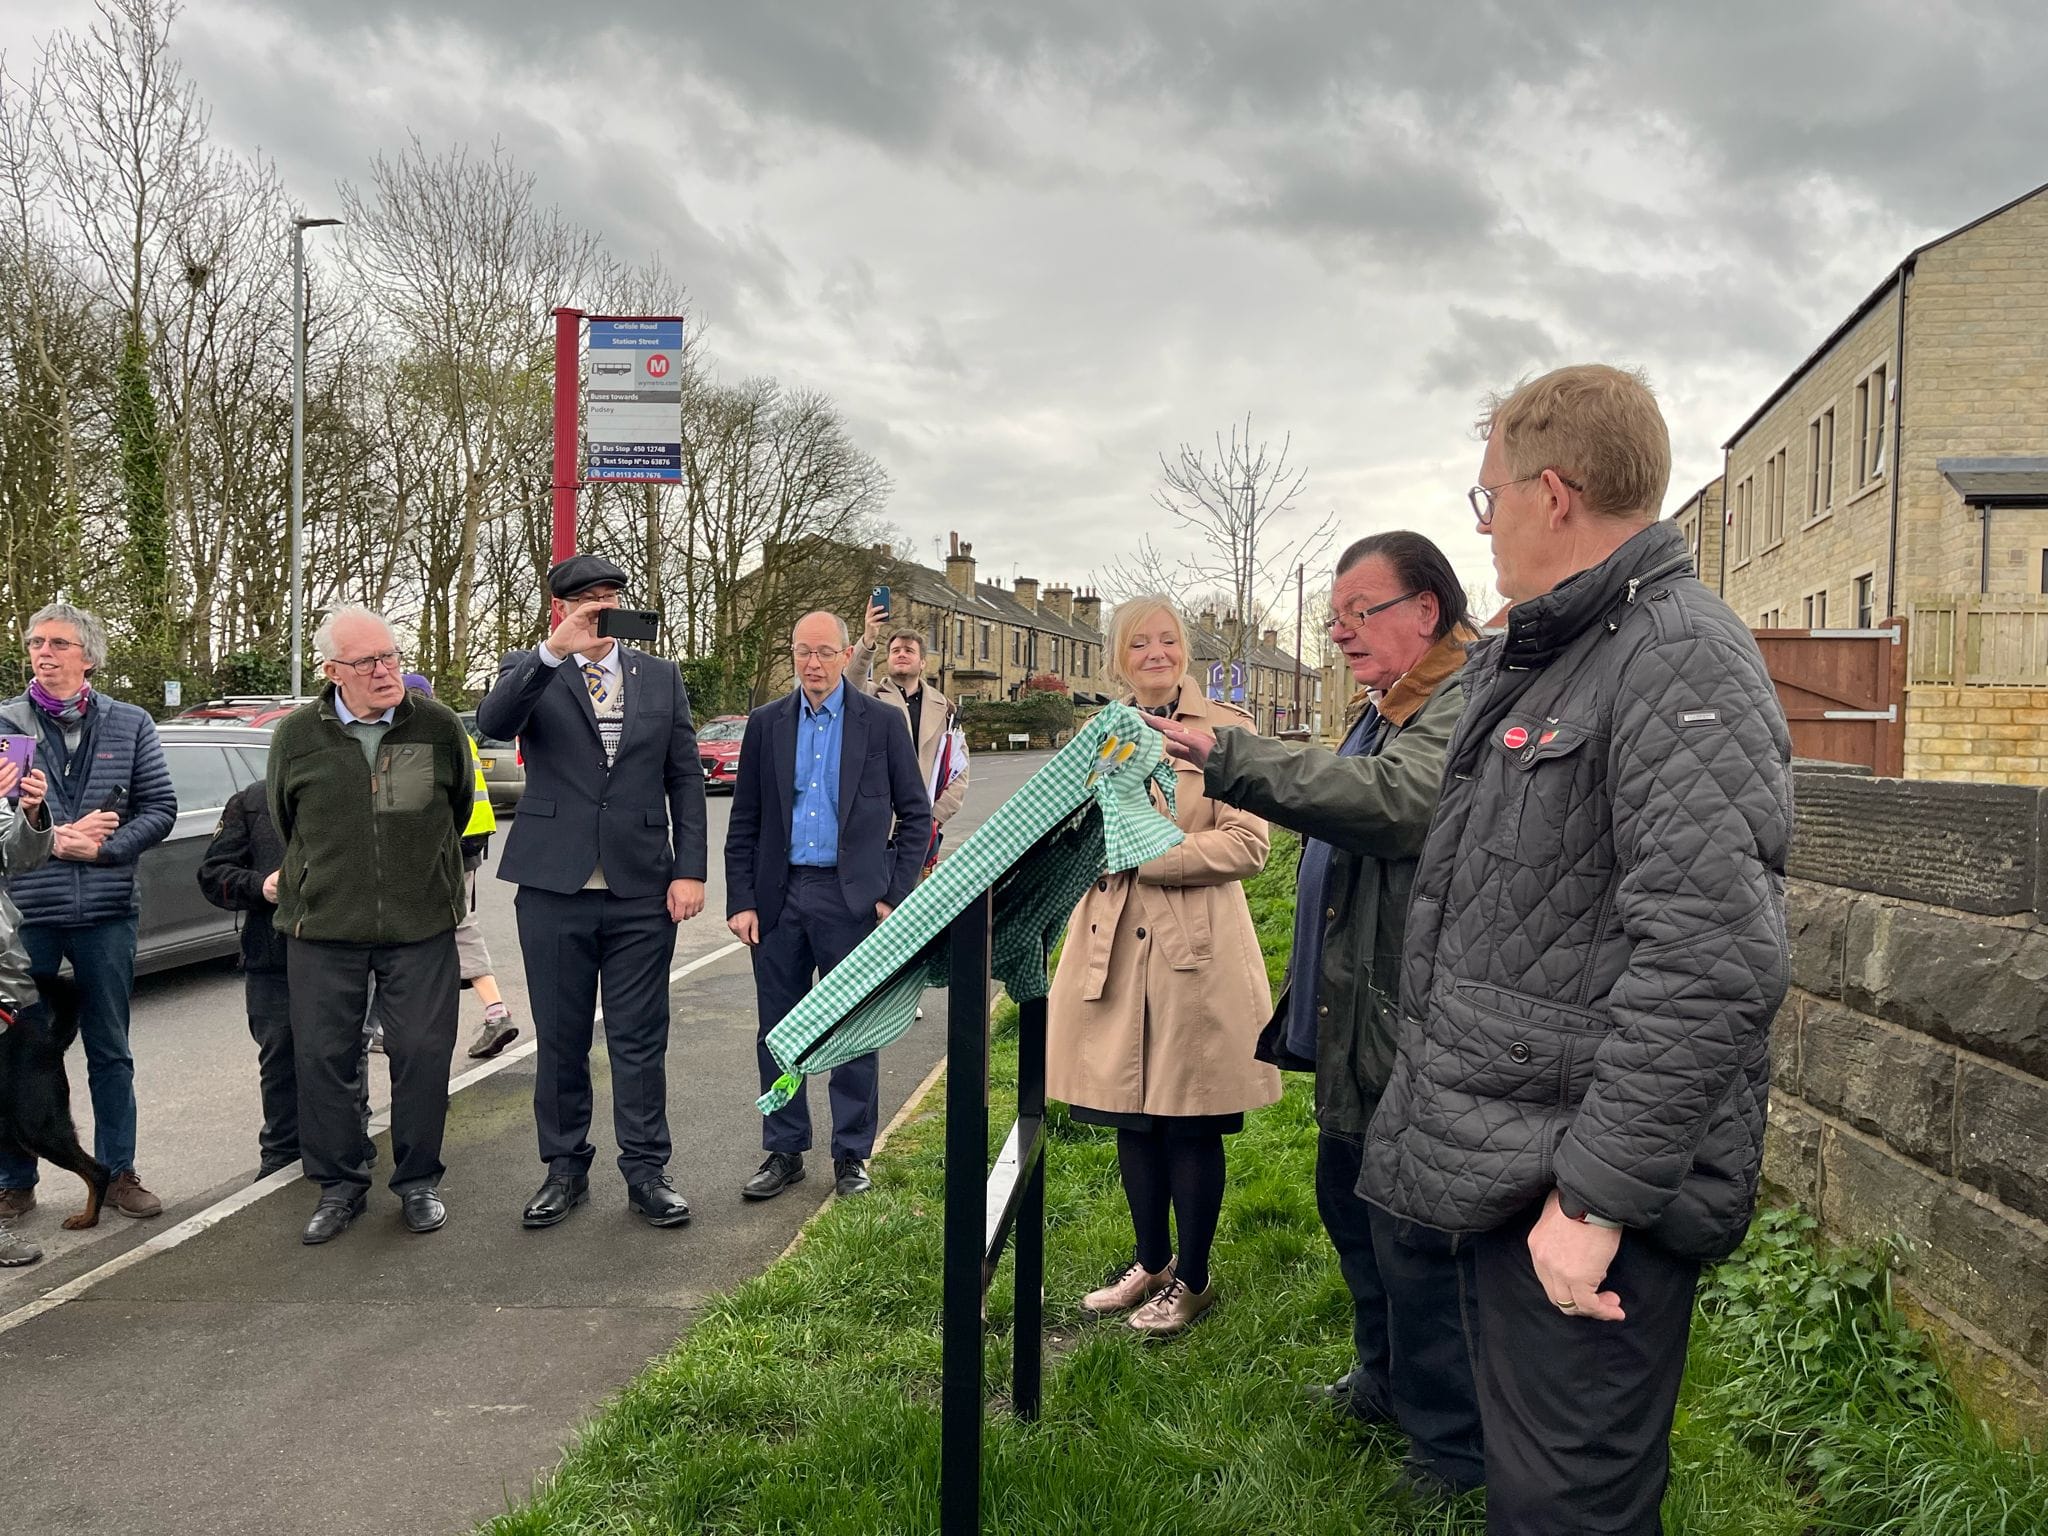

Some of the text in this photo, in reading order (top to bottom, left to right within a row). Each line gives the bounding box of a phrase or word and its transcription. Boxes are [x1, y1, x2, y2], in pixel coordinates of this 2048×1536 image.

[650, 359, 666, 373] M
[590, 406, 615, 414] Pudsey
[615, 445, 631, 453] Stop
[602, 457, 617, 465] Text
